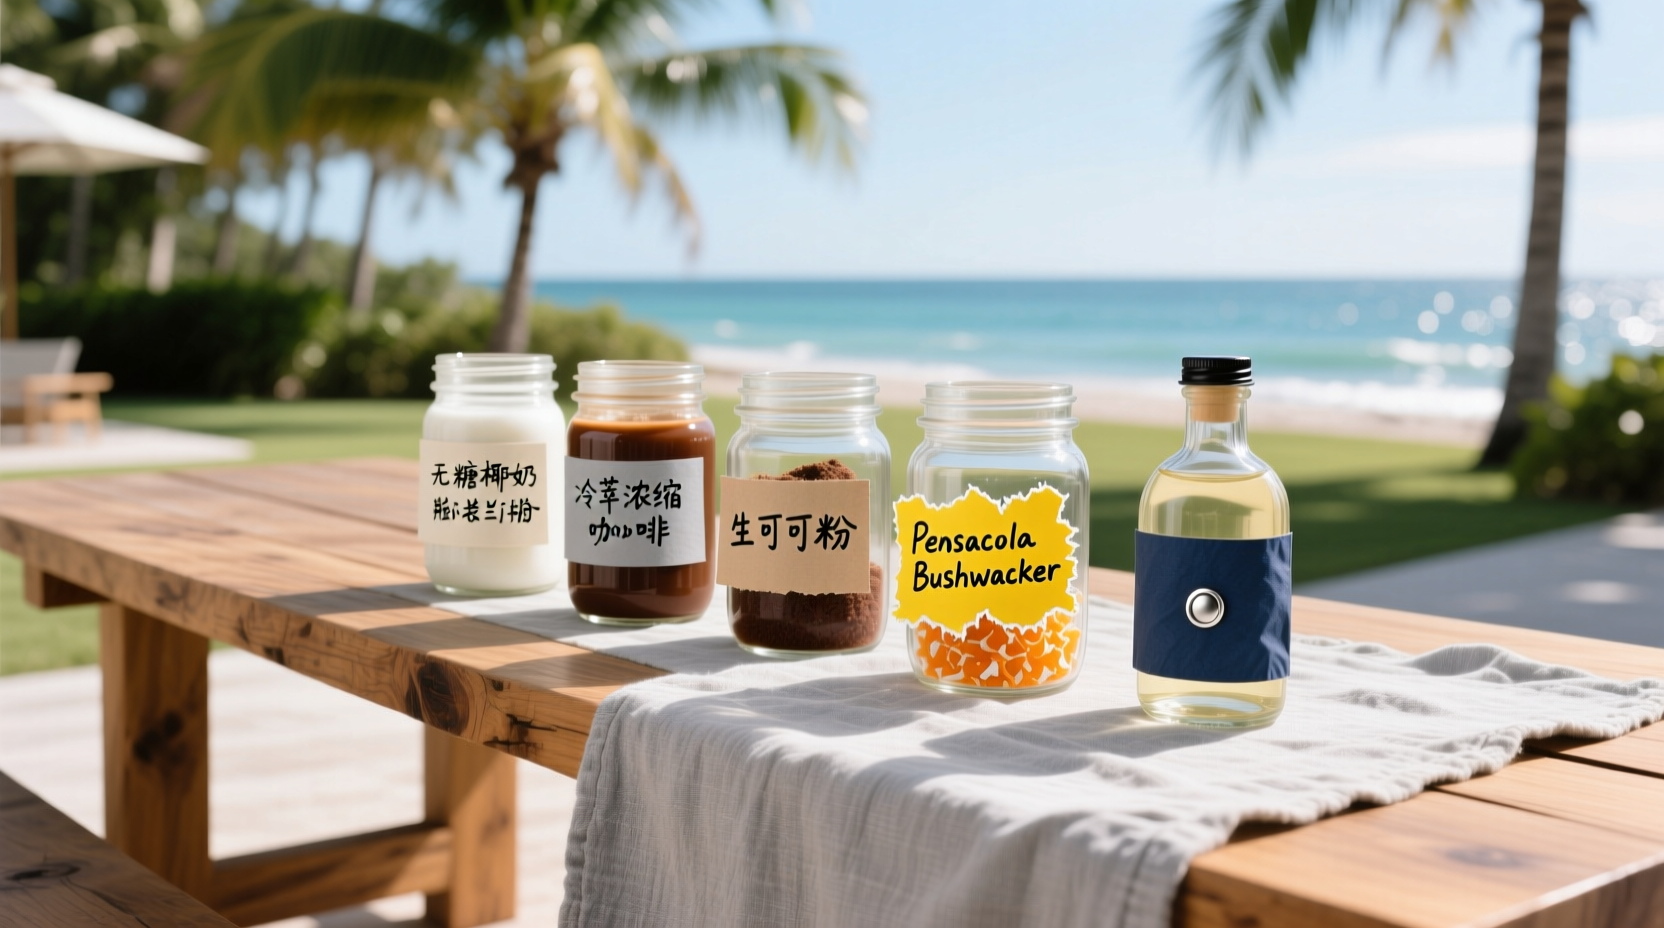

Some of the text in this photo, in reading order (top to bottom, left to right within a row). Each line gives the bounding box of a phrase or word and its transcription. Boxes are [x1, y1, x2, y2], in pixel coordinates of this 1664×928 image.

[431, 460, 537, 493] 无糖椰奶
[730, 511, 858, 552] 生可可粉
[912, 520, 1037, 555] Pensacola
[912, 558, 1062, 592] Bushwacker
